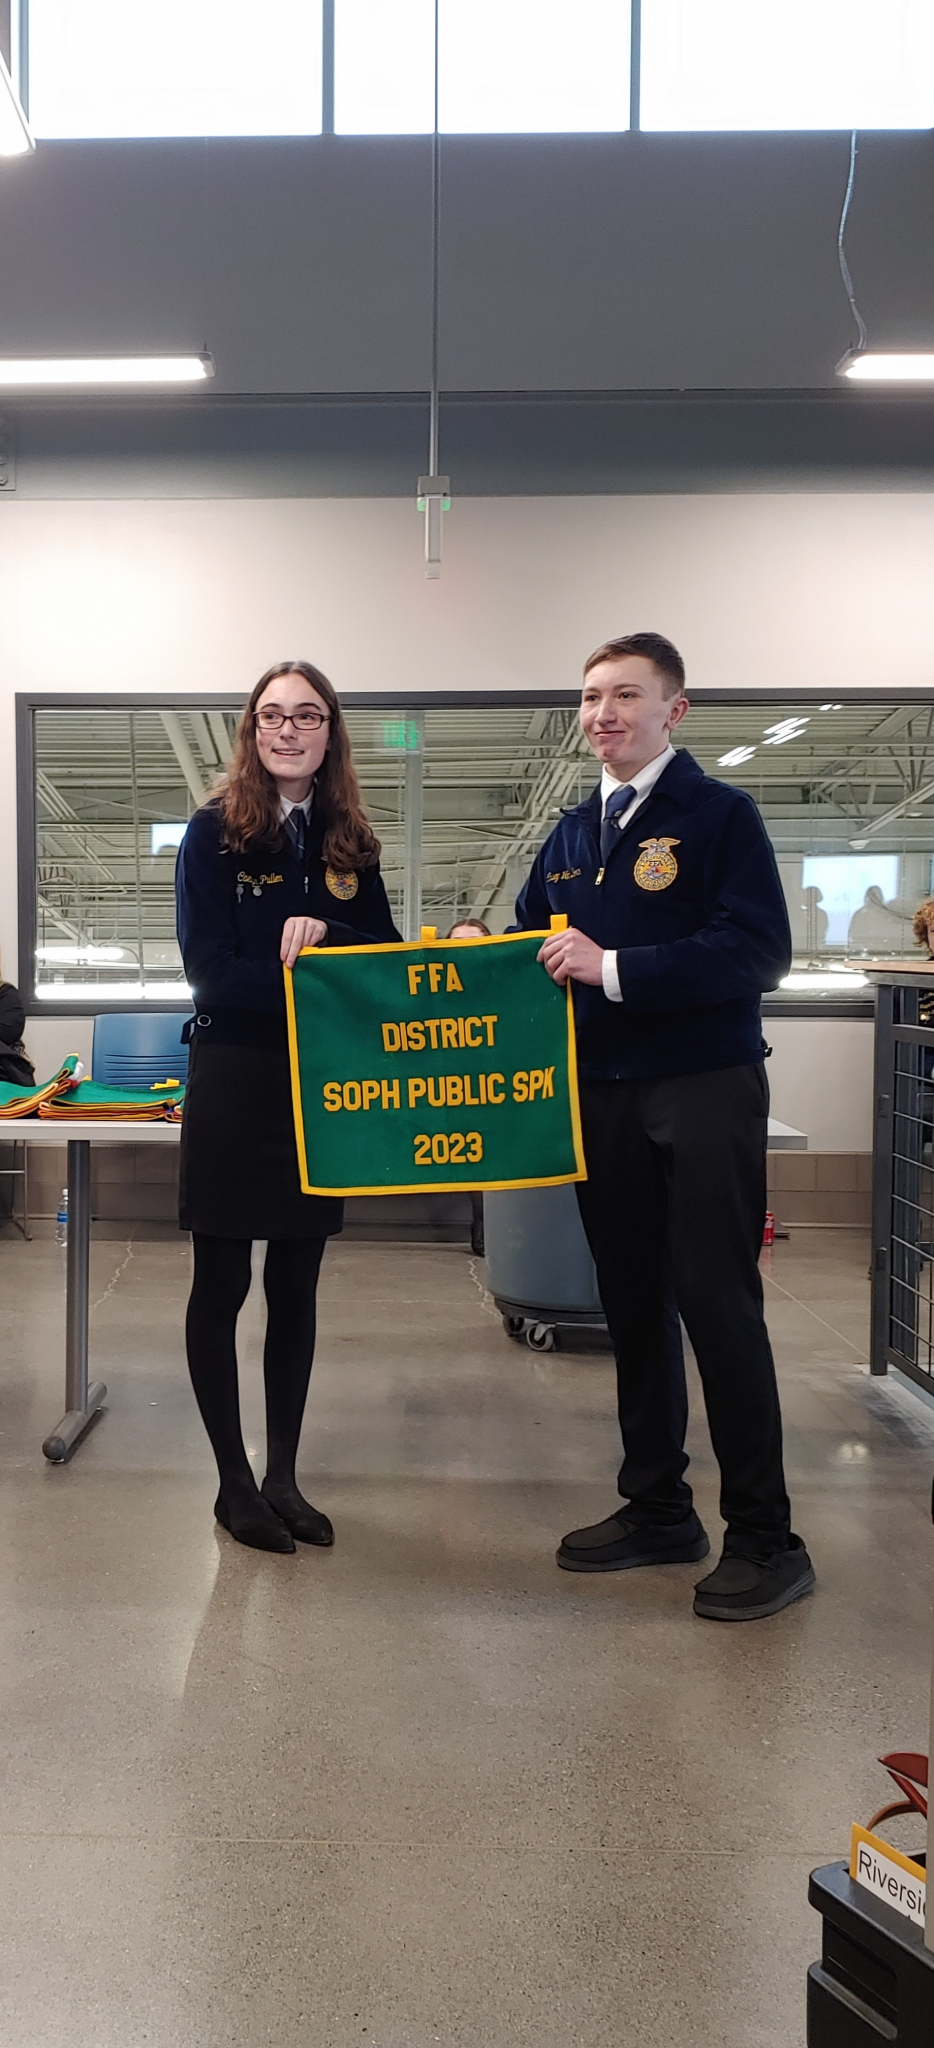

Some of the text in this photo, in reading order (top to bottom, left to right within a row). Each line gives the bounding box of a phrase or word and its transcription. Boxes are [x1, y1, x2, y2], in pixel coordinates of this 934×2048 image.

[407, 963, 464, 995] FFA
[381, 1015, 498, 1052] DISTRICT
[323, 1066, 556, 1112] SOPH PUBLIC SPK
[413, 1131, 483, 1165] 2023
